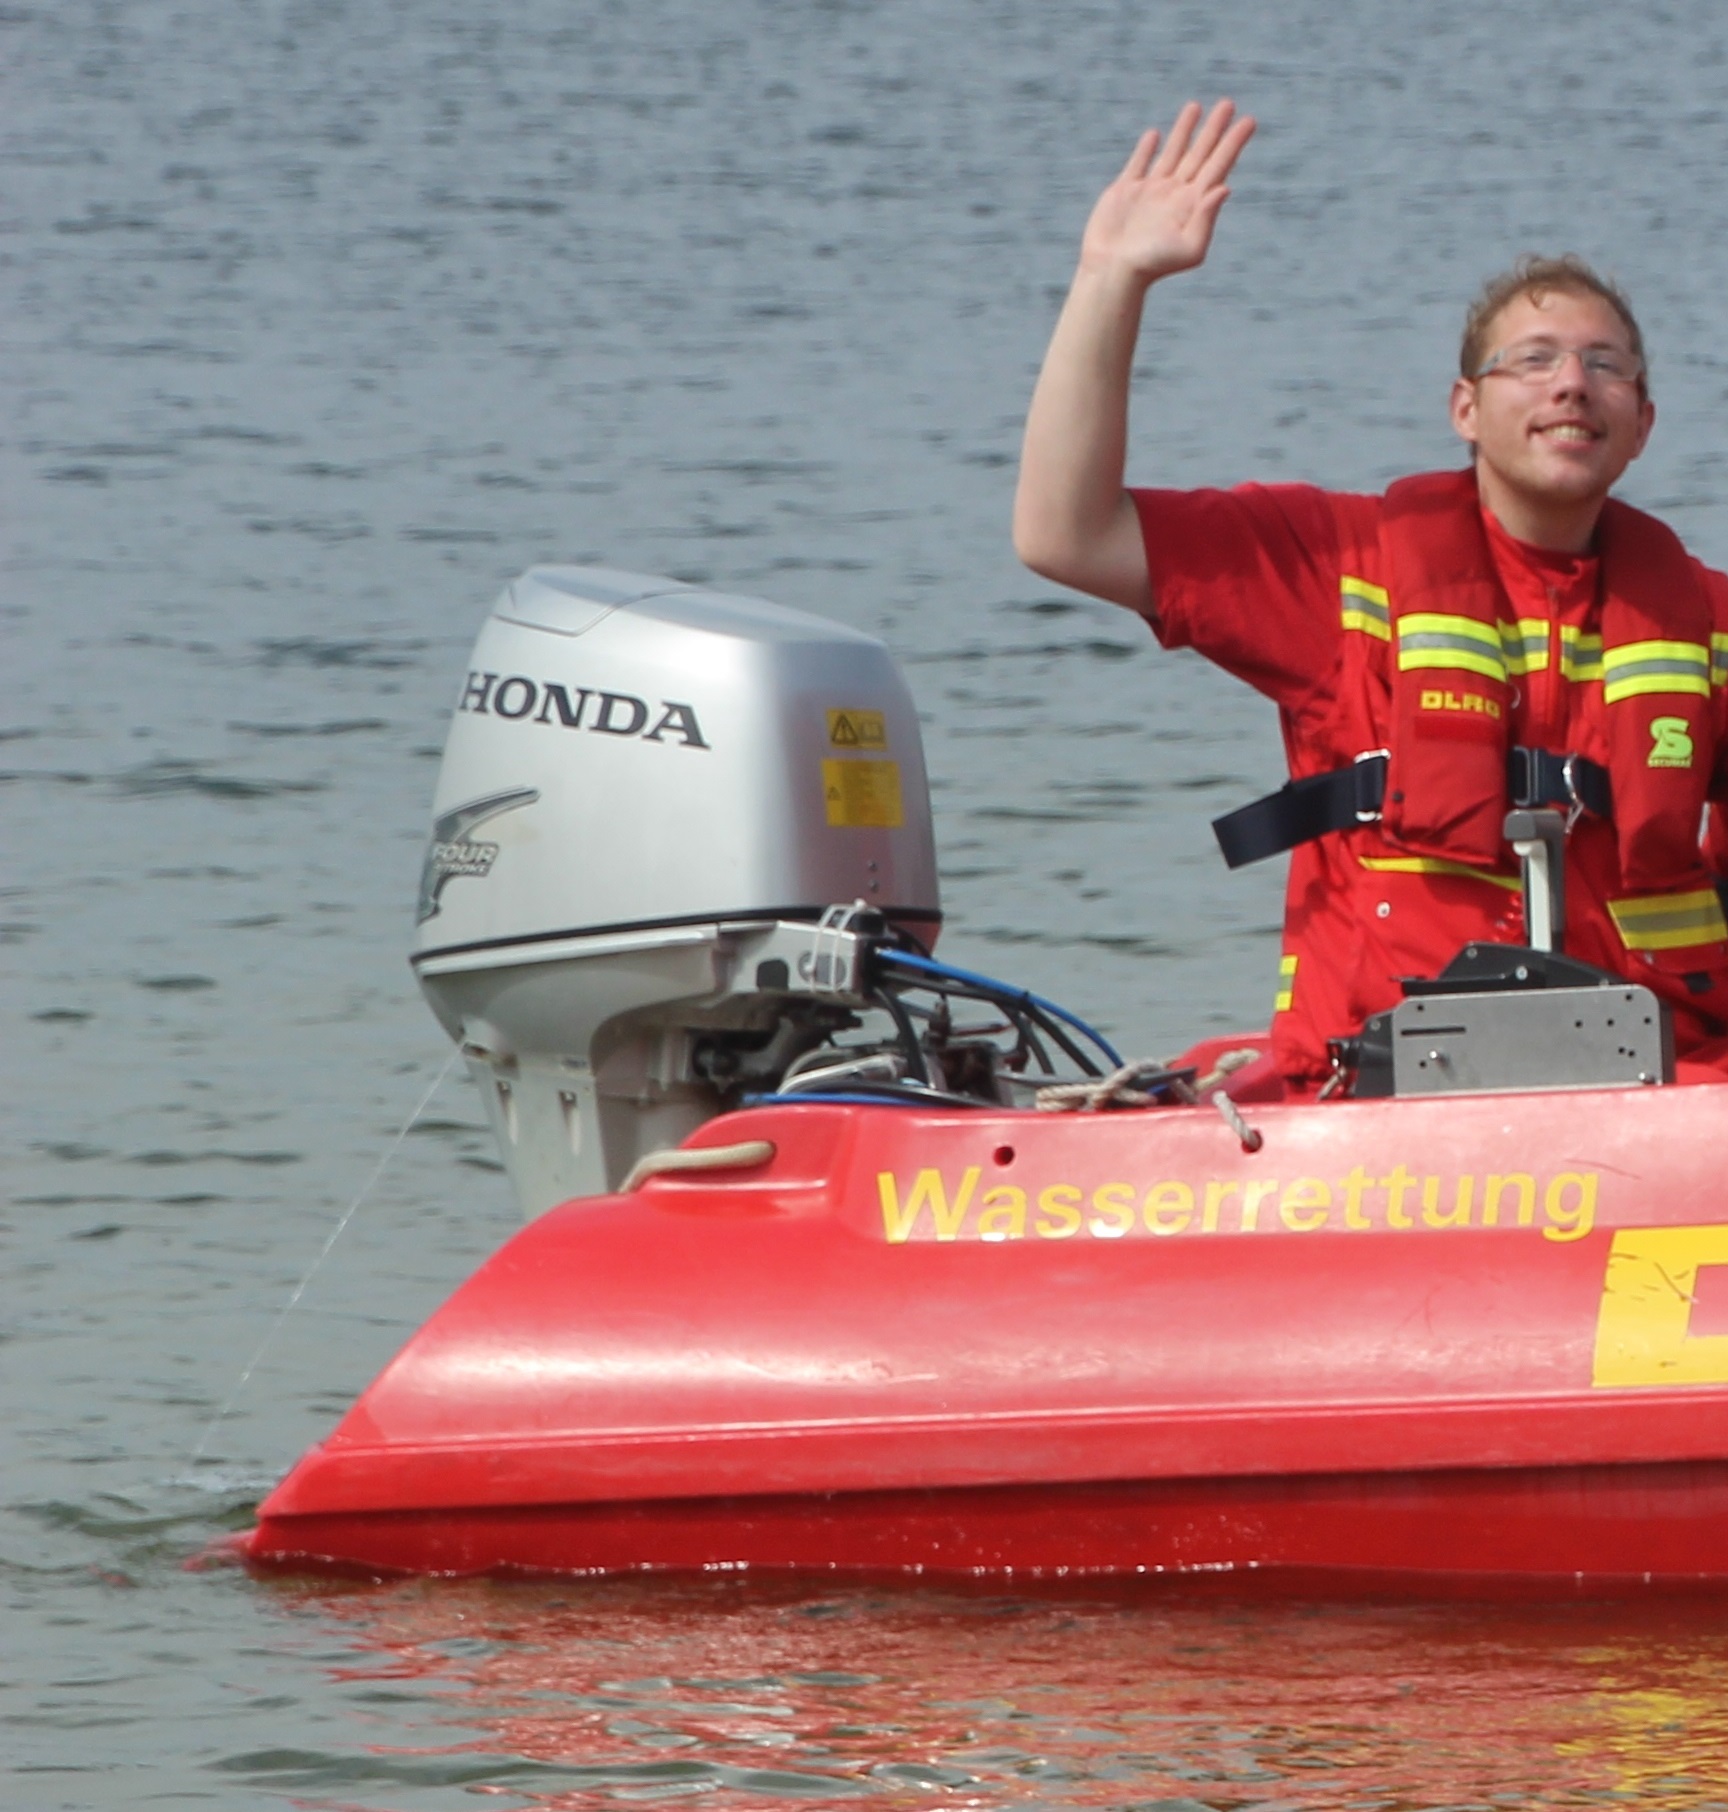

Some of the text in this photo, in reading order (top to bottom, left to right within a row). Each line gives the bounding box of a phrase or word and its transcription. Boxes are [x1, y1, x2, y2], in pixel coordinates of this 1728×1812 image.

[459, 672, 711, 750] HONDA
[1421, 689, 1500, 719] DLRG
[877, 1164, 1599, 1243] Wasserrettung
